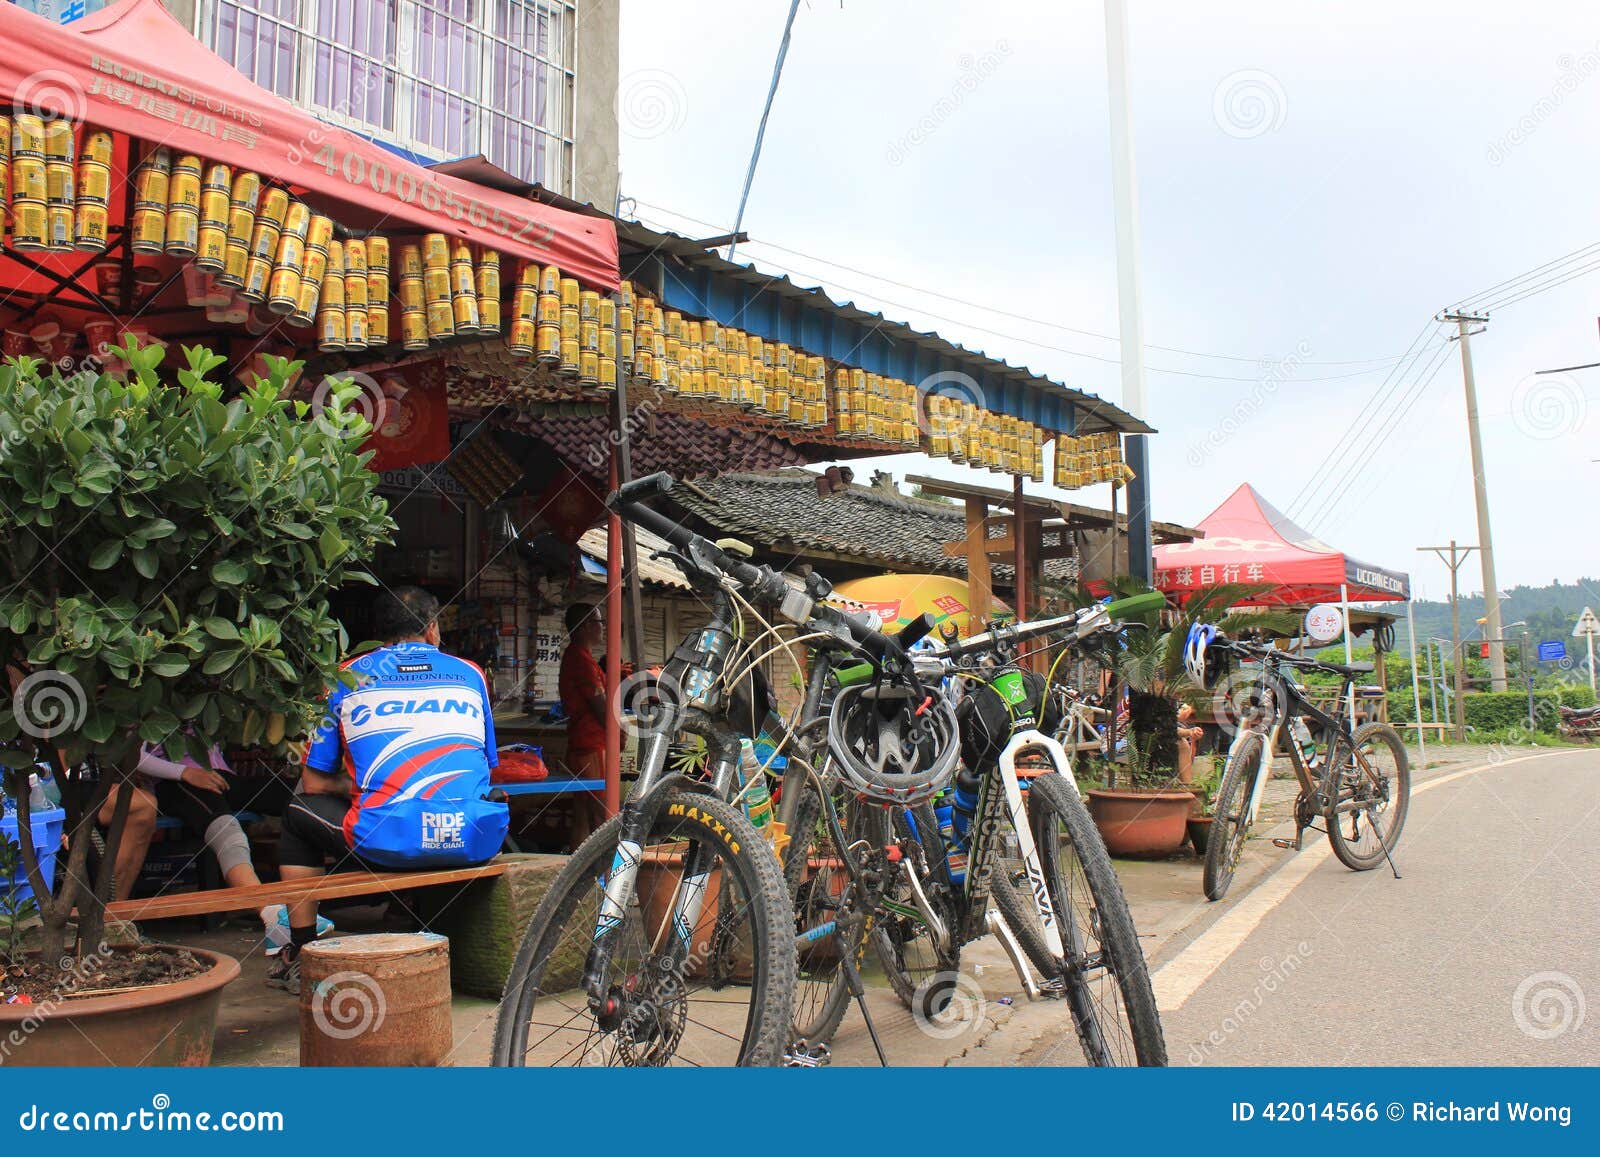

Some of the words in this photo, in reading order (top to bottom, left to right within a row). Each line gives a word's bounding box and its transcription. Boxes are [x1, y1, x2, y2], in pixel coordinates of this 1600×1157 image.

[313, 143, 556, 252] 4000656522
[1154, 563, 1264, 588] 环球自行车
[536, 634, 560, 647] 节约
[537, 649, 560, 662] 用水
[375, 699, 479, 719] GIANT
[422, 812, 465, 827] RIDE
[668, 804, 741, 855] MAXXIS
[422, 828, 461, 842] LIFE
[1026, 856, 1053, 927] JAVA
